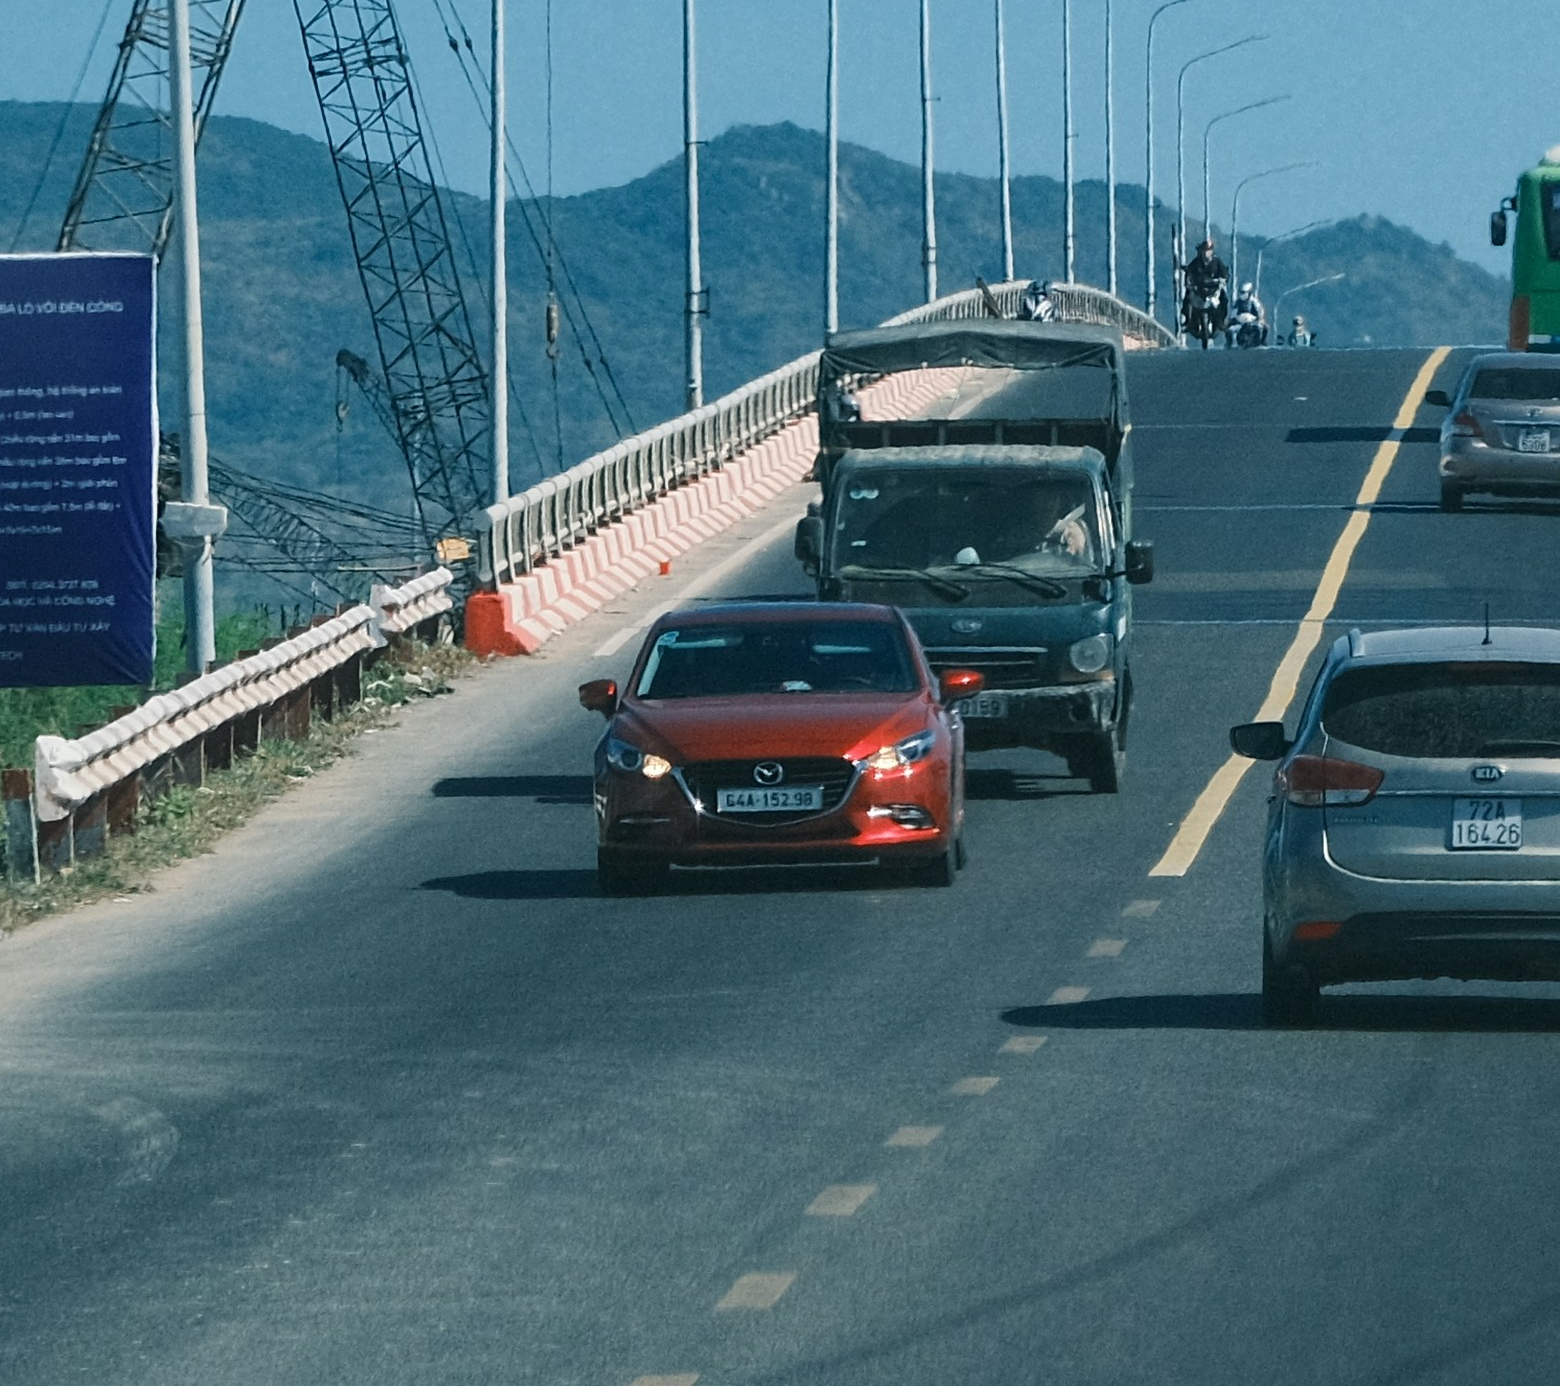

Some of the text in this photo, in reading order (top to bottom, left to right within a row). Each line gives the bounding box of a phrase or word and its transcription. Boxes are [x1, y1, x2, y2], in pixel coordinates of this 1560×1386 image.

[1475, 768, 1500, 780] KIA
[1470, 800, 1506, 821] 72A
[1457, 823, 1520, 846] 164.26
